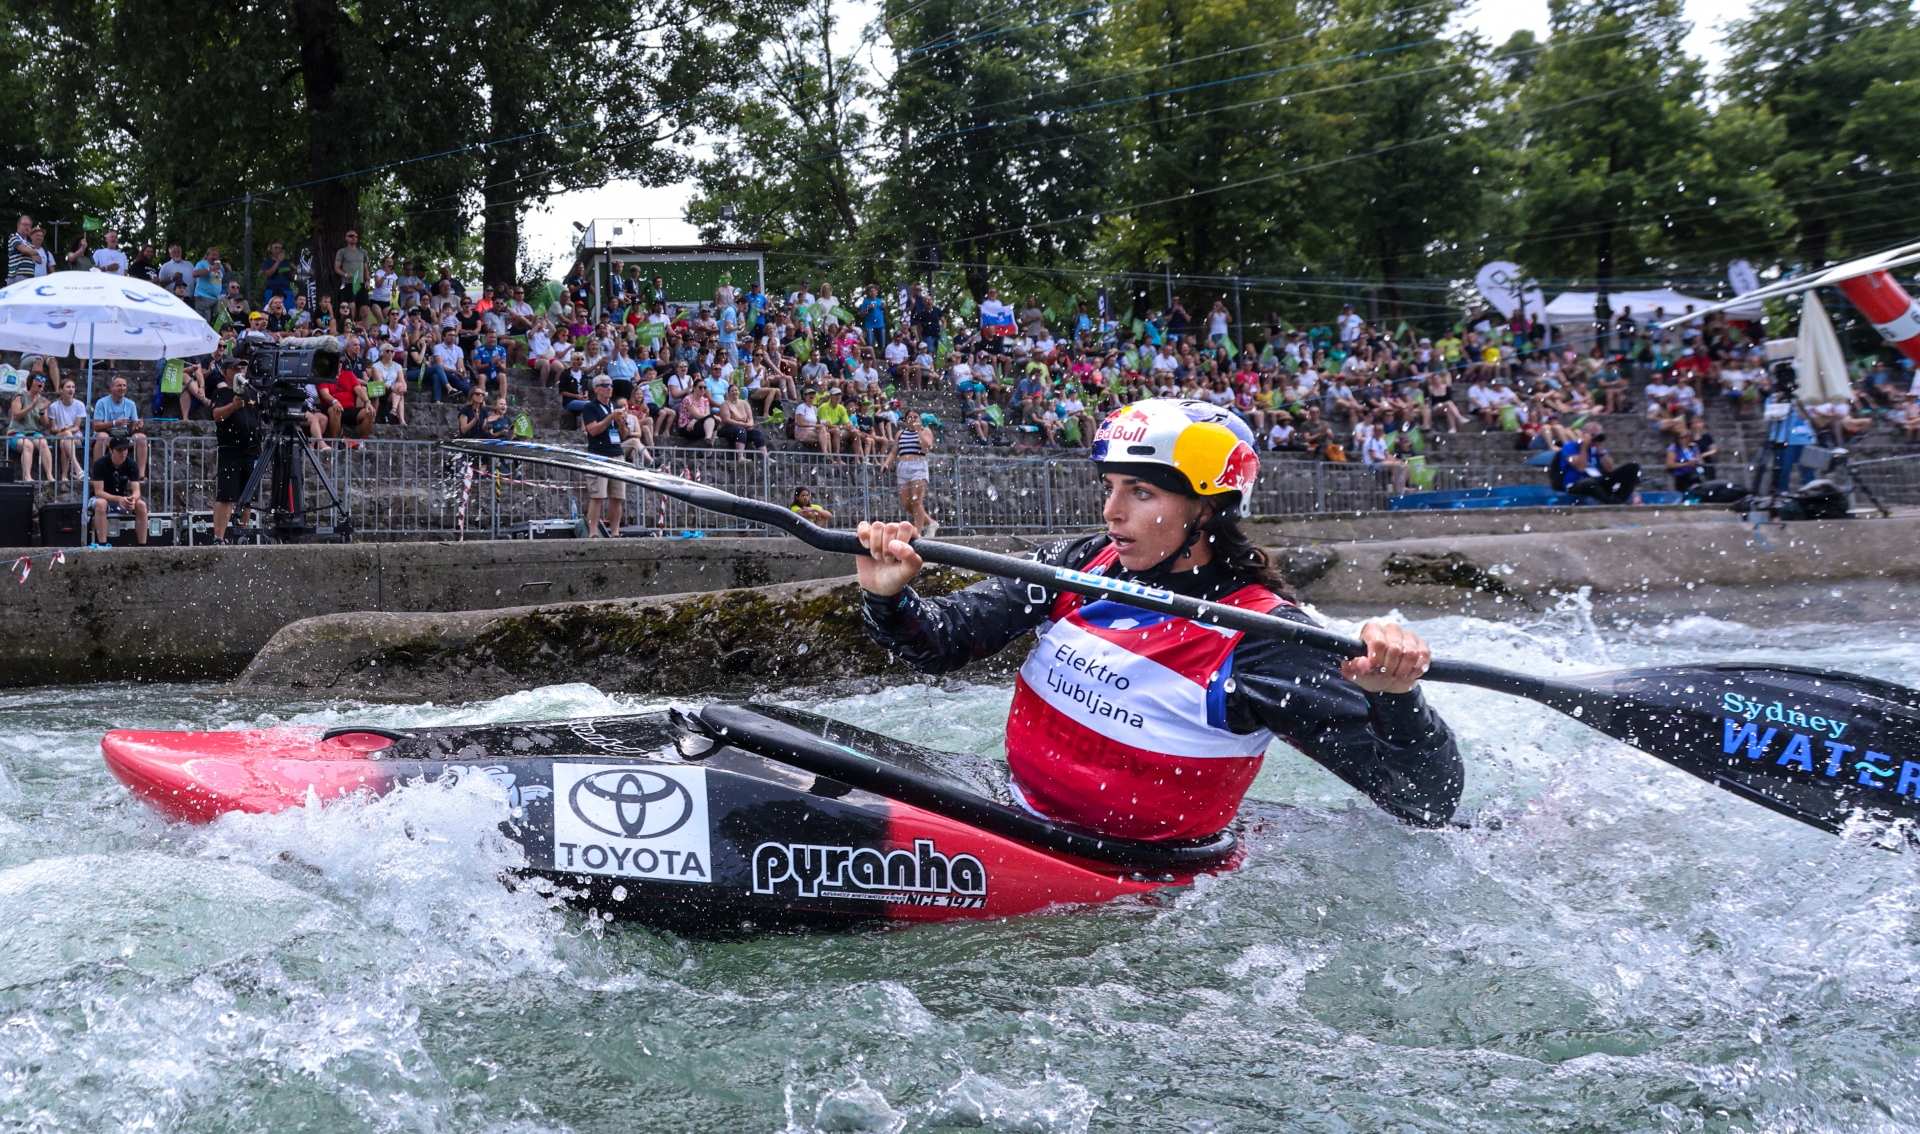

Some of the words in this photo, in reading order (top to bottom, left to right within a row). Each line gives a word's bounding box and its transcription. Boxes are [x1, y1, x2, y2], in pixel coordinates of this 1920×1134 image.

[1112, 425, 1147, 443] Bull
[1055, 644, 1130, 690] Elektro
[1047, 668, 1144, 729] Ljubljana
[1723, 692, 1848, 739] Sydney
[1046, 712, 1152, 777] triglav
[1722, 717, 1920, 800] WATER
[559, 842, 707, 878] TOYOTA
[752, 840, 987, 898] pyranha
[944, 896, 987, 909] 1971
